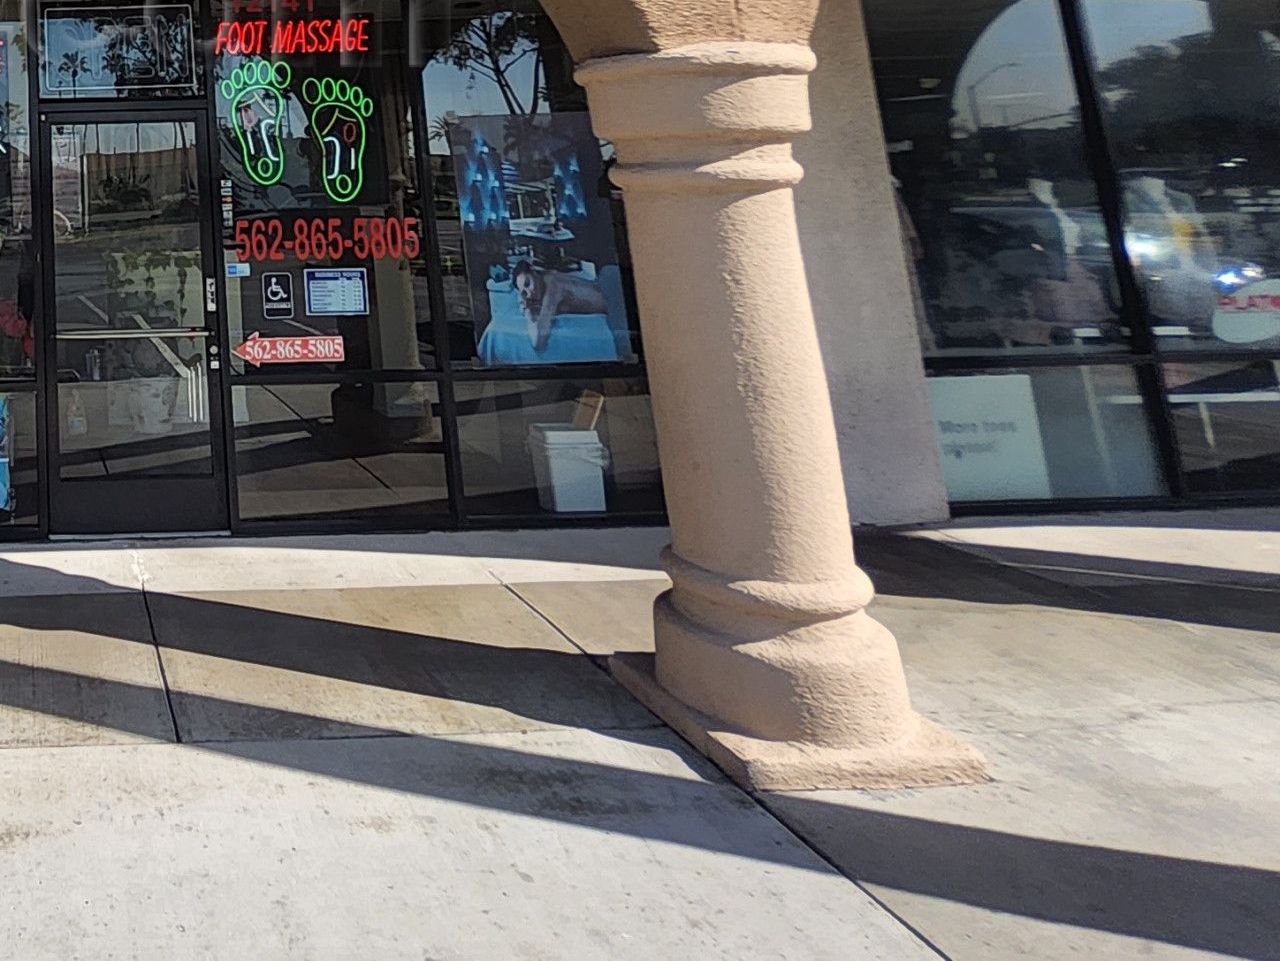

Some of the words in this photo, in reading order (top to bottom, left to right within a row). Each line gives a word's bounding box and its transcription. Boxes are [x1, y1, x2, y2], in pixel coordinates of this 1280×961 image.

[215, 21, 268, 55] FOOT
[271, 19, 369, 54] MASSAGE
[235, 217, 420, 262] 562-865-5805
[245, 339, 343, 360] 562-865-5805
